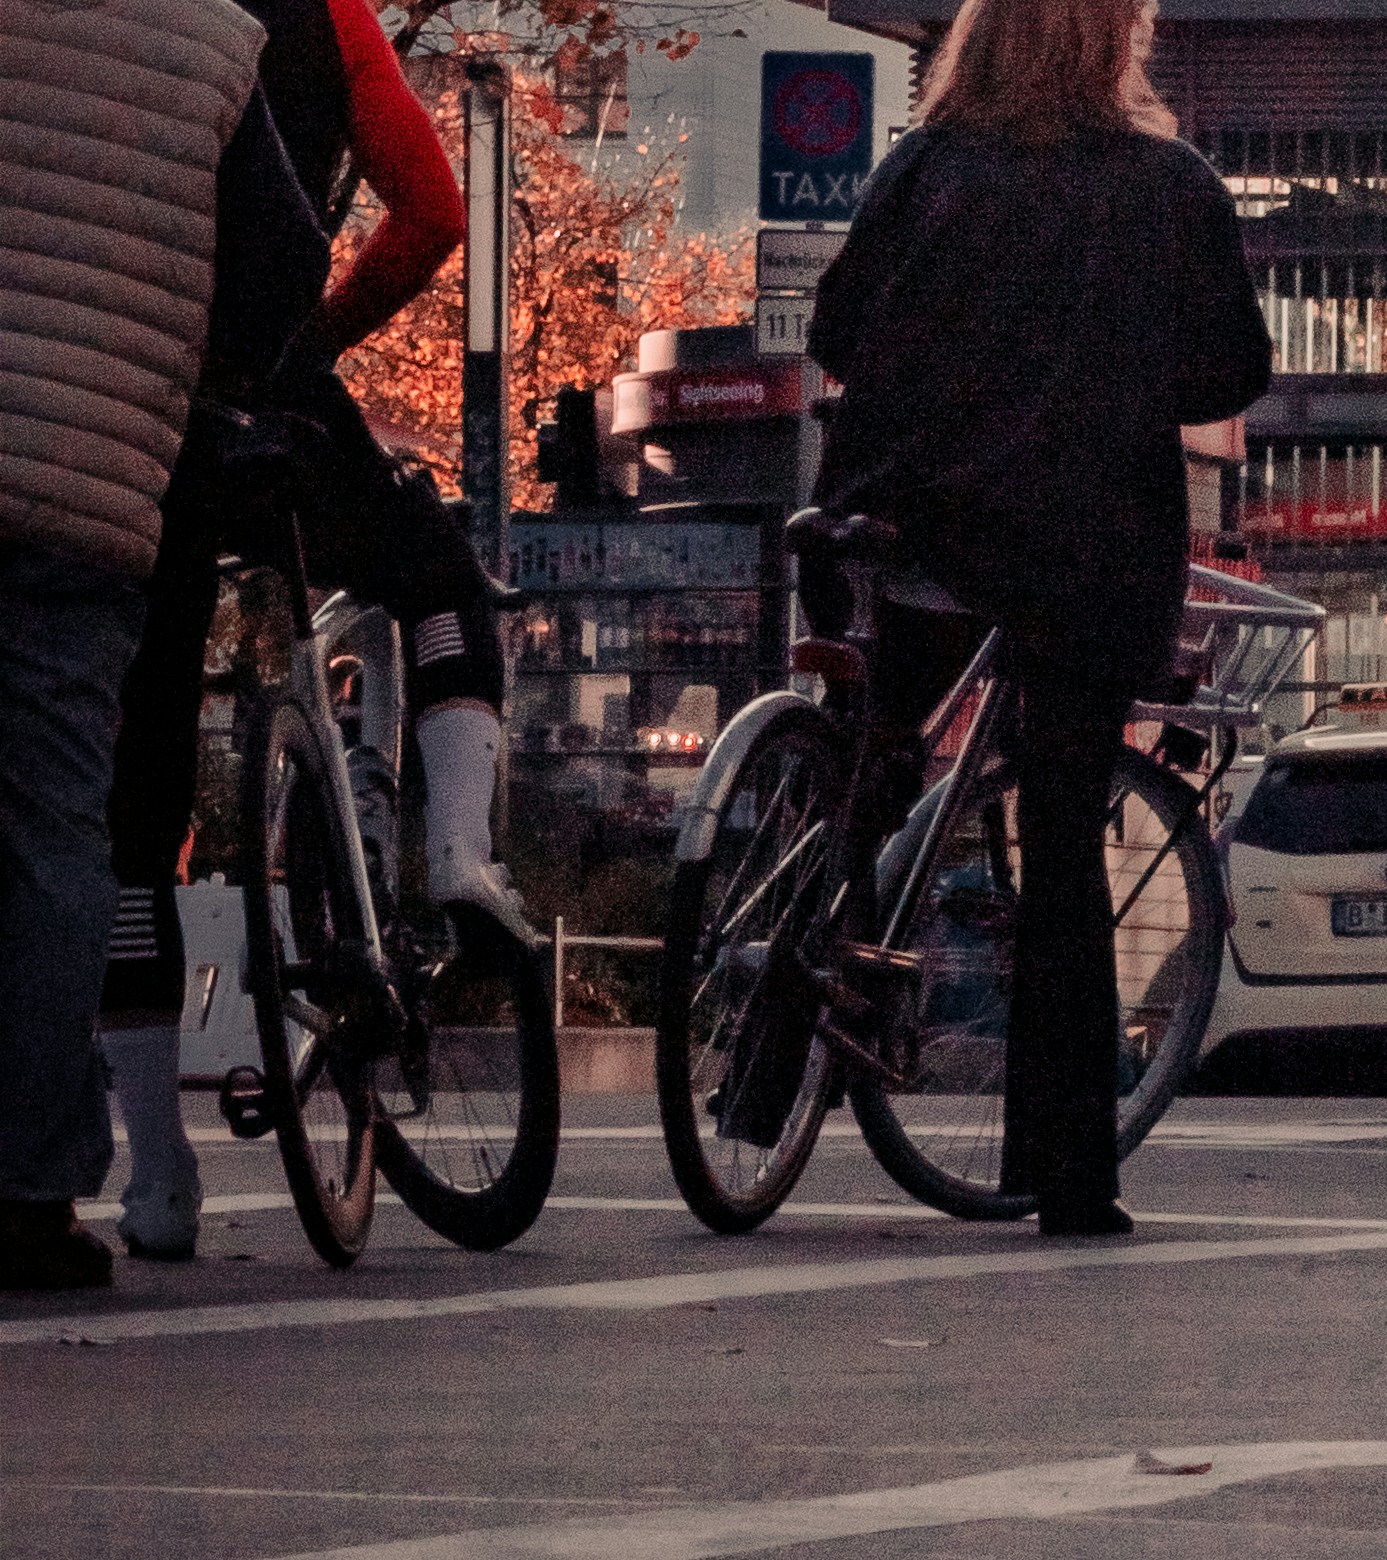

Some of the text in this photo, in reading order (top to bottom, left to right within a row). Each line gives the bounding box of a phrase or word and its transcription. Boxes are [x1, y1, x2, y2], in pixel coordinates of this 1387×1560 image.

[772, 171, 862, 206] TAXI
[767, 313, 787, 340] 11
[1348, 904, 1363, 927] B
